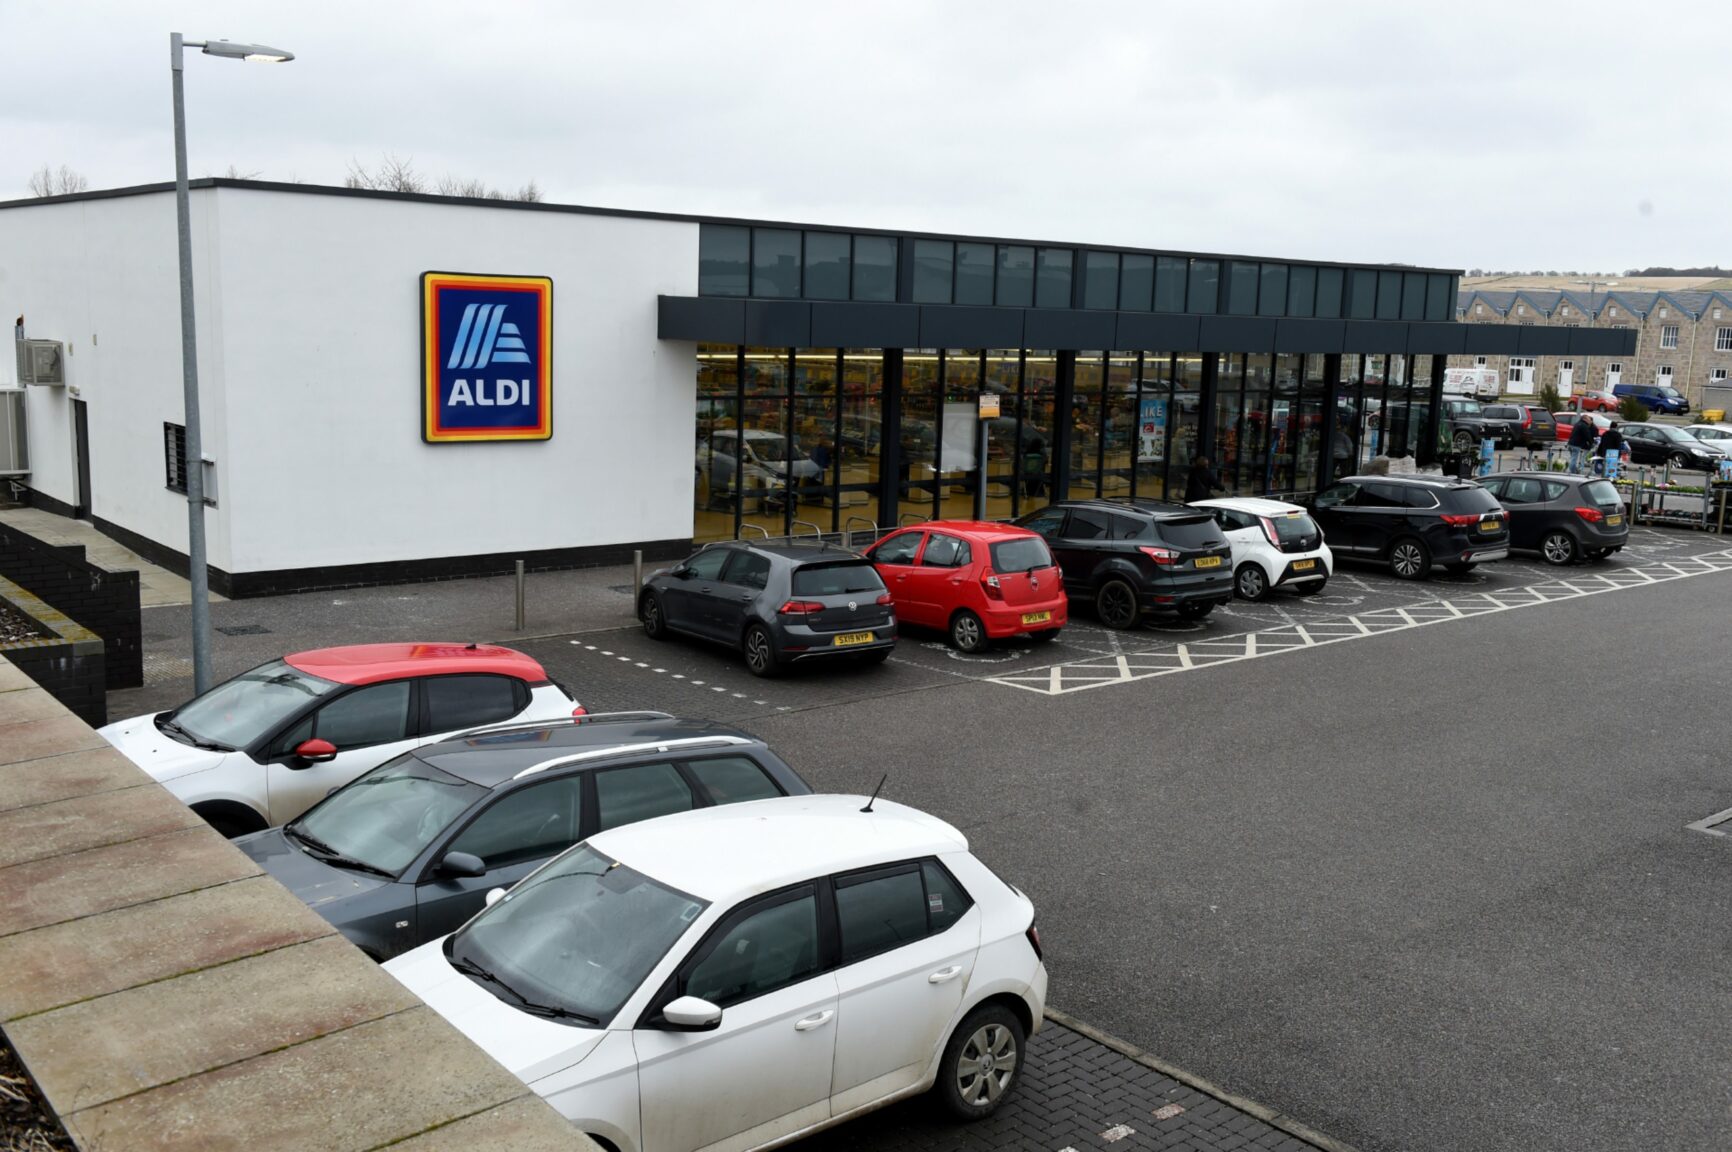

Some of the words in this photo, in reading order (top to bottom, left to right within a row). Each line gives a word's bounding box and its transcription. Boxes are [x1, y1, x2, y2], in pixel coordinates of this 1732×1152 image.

[447, 379, 530, 406] ALDI
[839, 634, 854, 644] SX19
[855, 632, 869, 643] NYP
